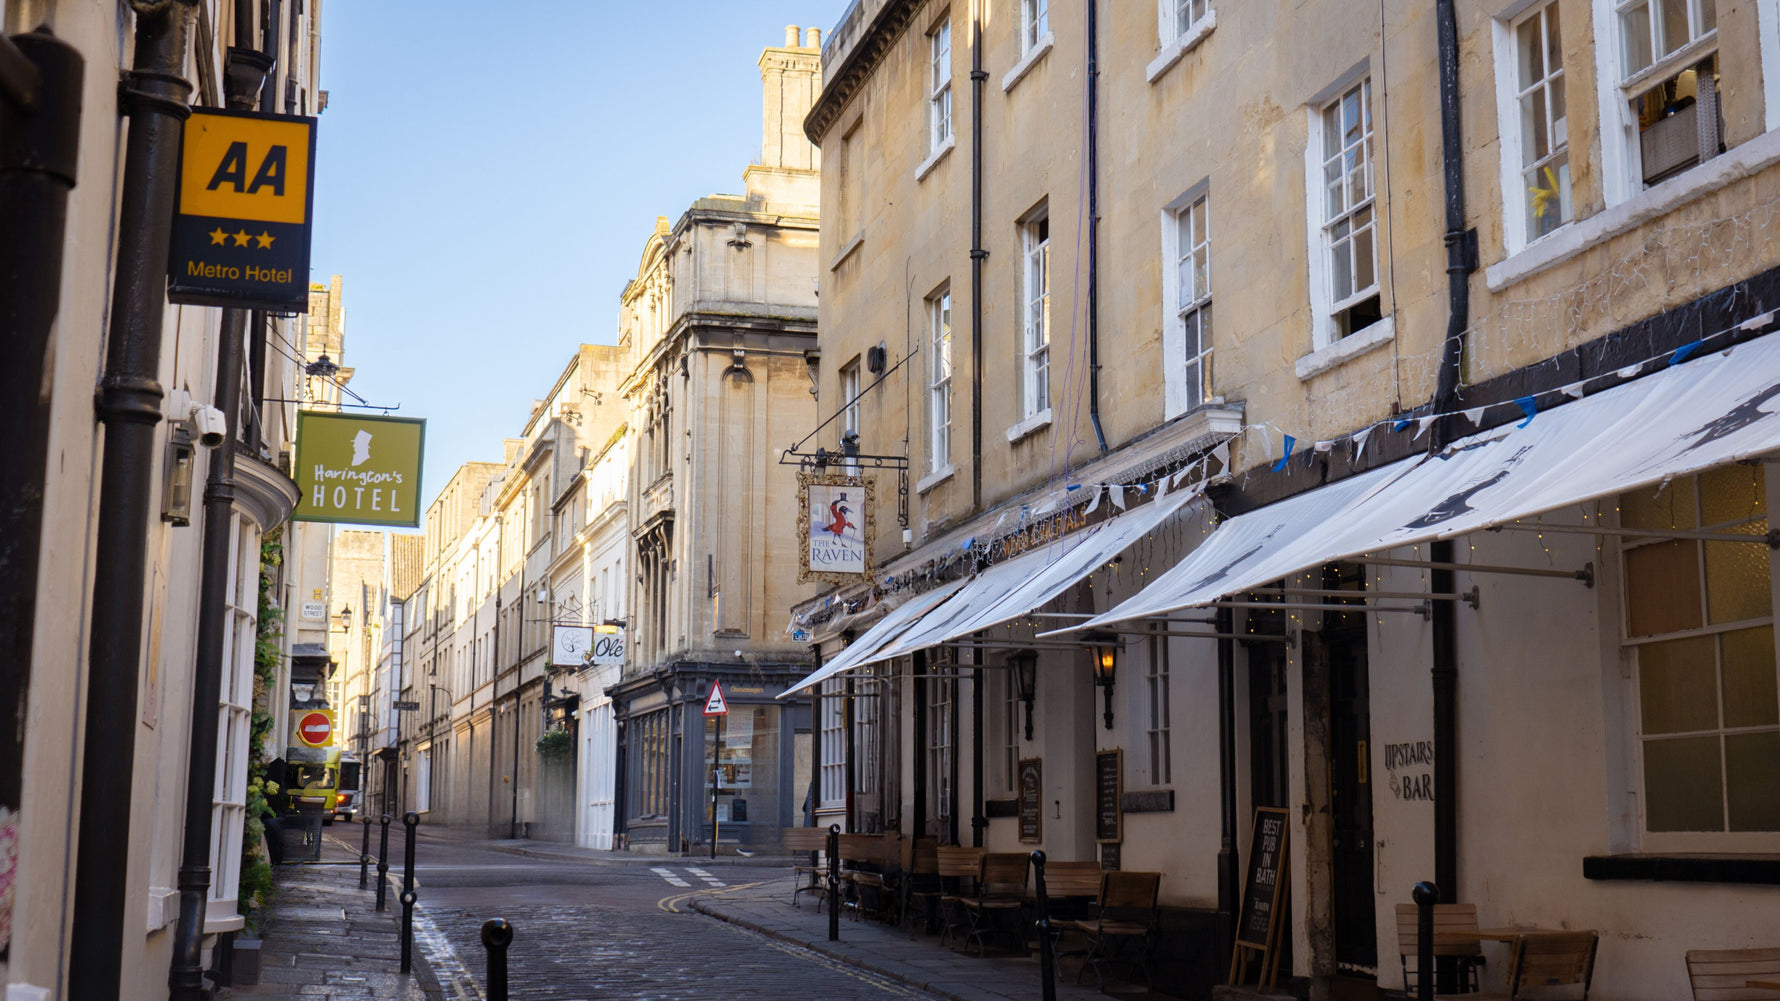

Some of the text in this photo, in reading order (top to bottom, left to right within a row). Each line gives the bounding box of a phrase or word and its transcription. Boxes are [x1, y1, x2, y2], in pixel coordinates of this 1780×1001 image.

[206, 141, 287, 196] AA
[187, 260, 292, 283] Metro Hotel
[314, 463, 403, 486] Harington's
[312, 484, 400, 512] HOTEL
[812, 540, 830, 548] THE
[812, 547, 863, 565] RAVEN
[595, 636, 624, 658] Olé
[1384, 740, 1433, 770] UPSTAIRS
[1402, 773, 1434, 801] BAR
[1263, 818, 1282, 835] BEST
[1262, 835, 1277, 852] PUB
[1261, 852, 1271, 867] IN
[1255, 867, 1276, 885] BATH
